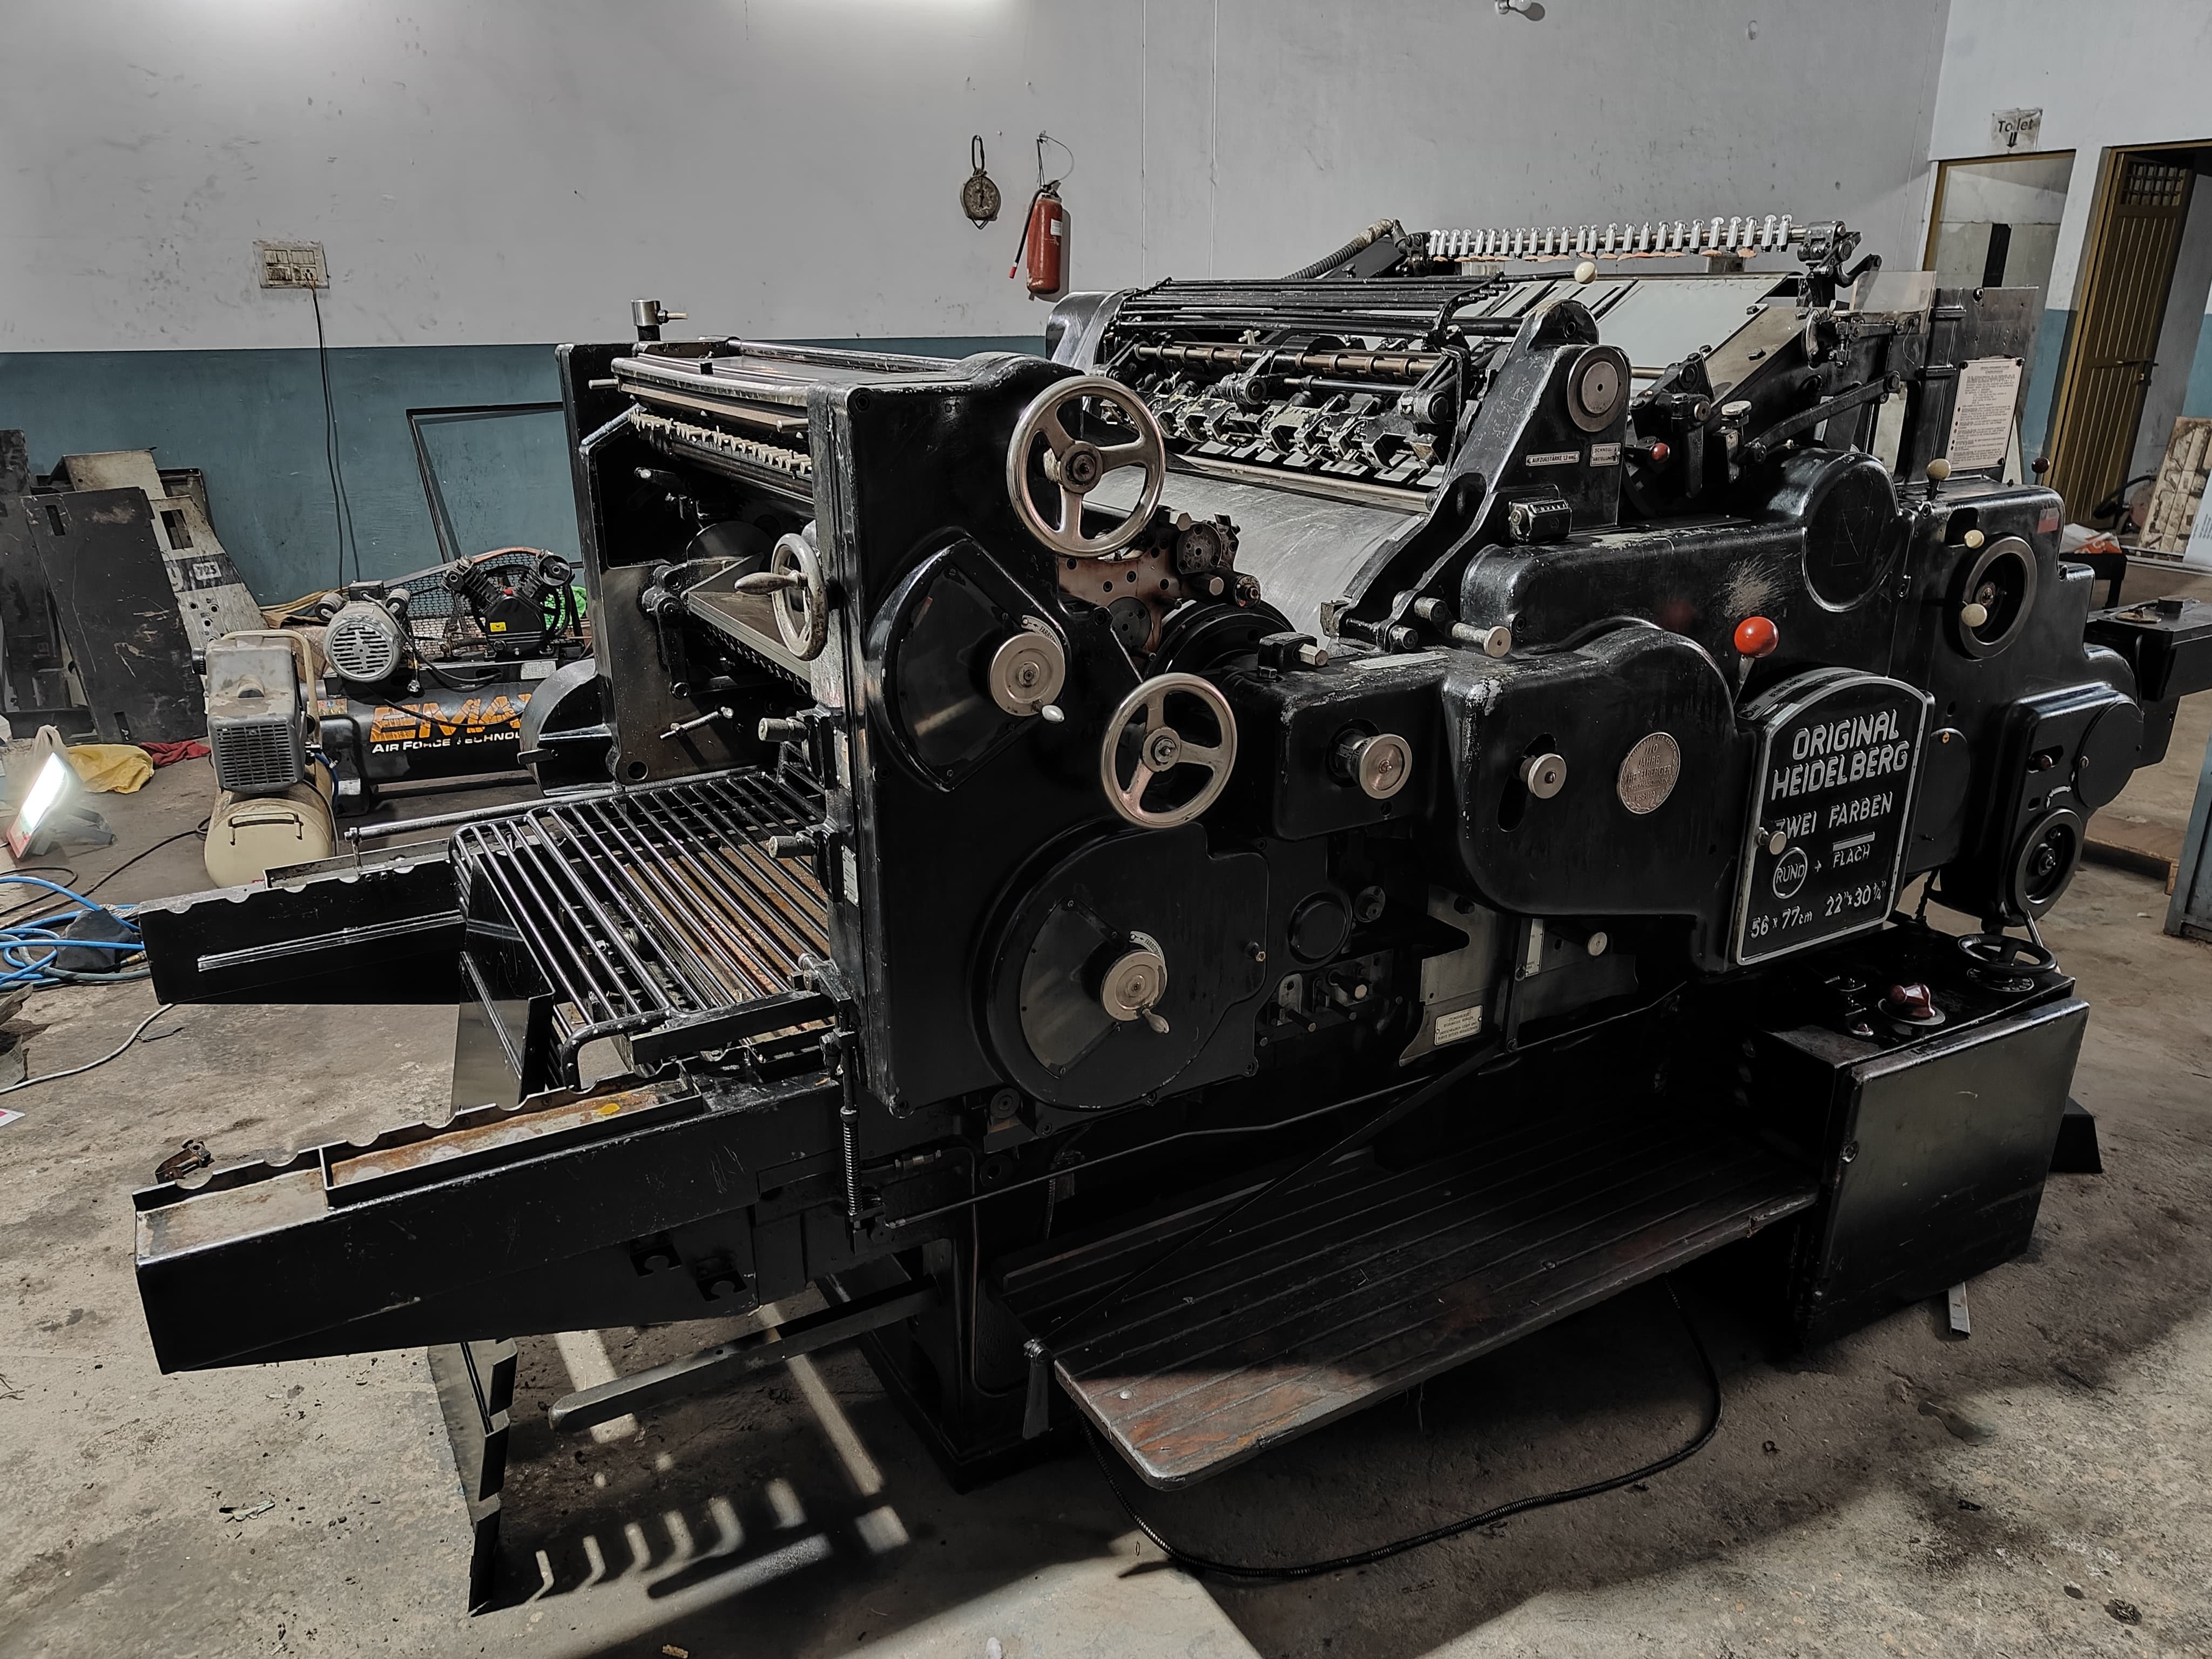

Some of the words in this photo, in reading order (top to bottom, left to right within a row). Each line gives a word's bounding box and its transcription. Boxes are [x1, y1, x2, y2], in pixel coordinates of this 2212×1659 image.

[1998, 118, 2034, 133] Tolet
[1792, 709, 1899, 760] ORIGINAL
[372, 743, 399, 754] AIR
[1645, 743, 1658, 755] 110
[1637, 755, 1661, 769] JAHRE
[1771, 740, 1910, 801] HEIDELBERG
[1627, 765, 1671, 783] HEIDELBERGER
[1775, 811, 1817, 839] ZWEI
[1829, 791, 1893, 829] FARBEN
[1776, 863, 1805, 885] RUND
[1833, 843, 1870, 868] FLACH
[1750, 915, 1770, 939] 56
